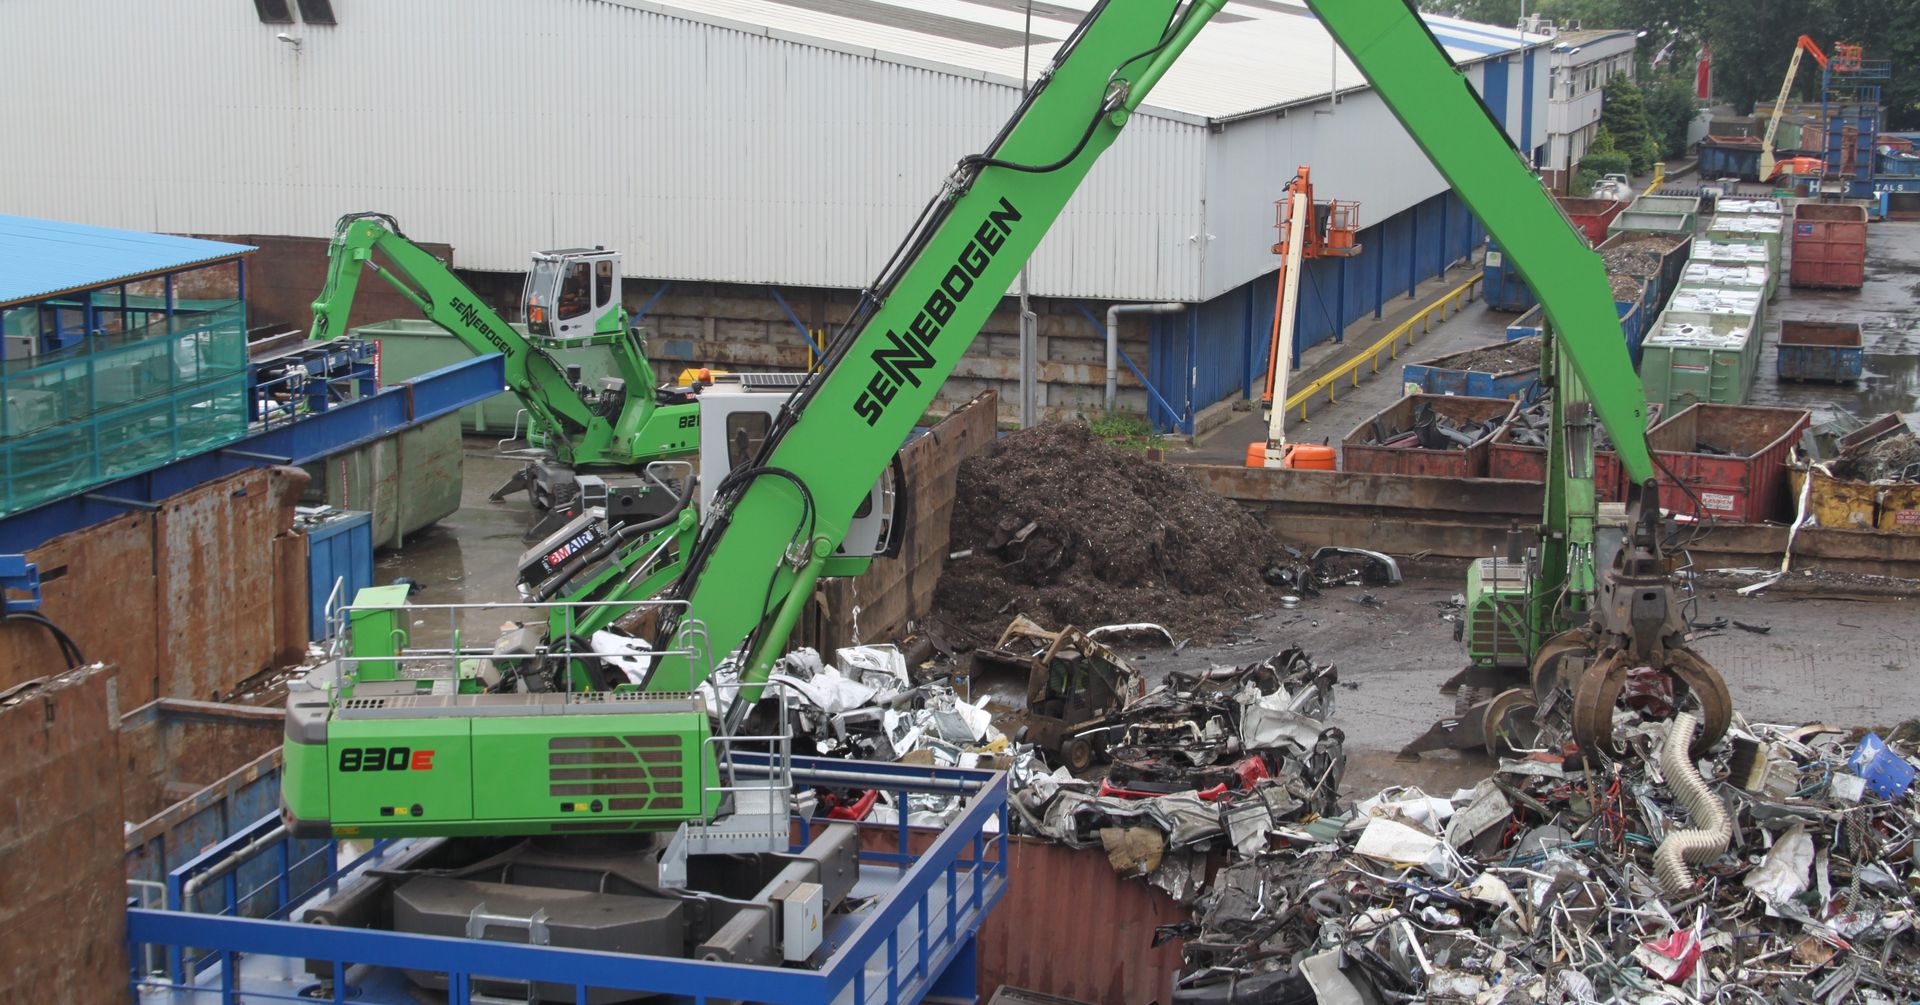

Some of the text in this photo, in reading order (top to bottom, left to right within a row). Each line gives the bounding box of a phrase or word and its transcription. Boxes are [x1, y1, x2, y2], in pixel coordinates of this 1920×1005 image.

[1809, 180, 1904, 193] HS TALS
[449, 296, 515, 358] SENNEBOGEN
[852, 196, 1023, 427] SENNEBOGEN
[547, 530, 594, 566] BMAIR
[339, 747, 435, 772] 830E
